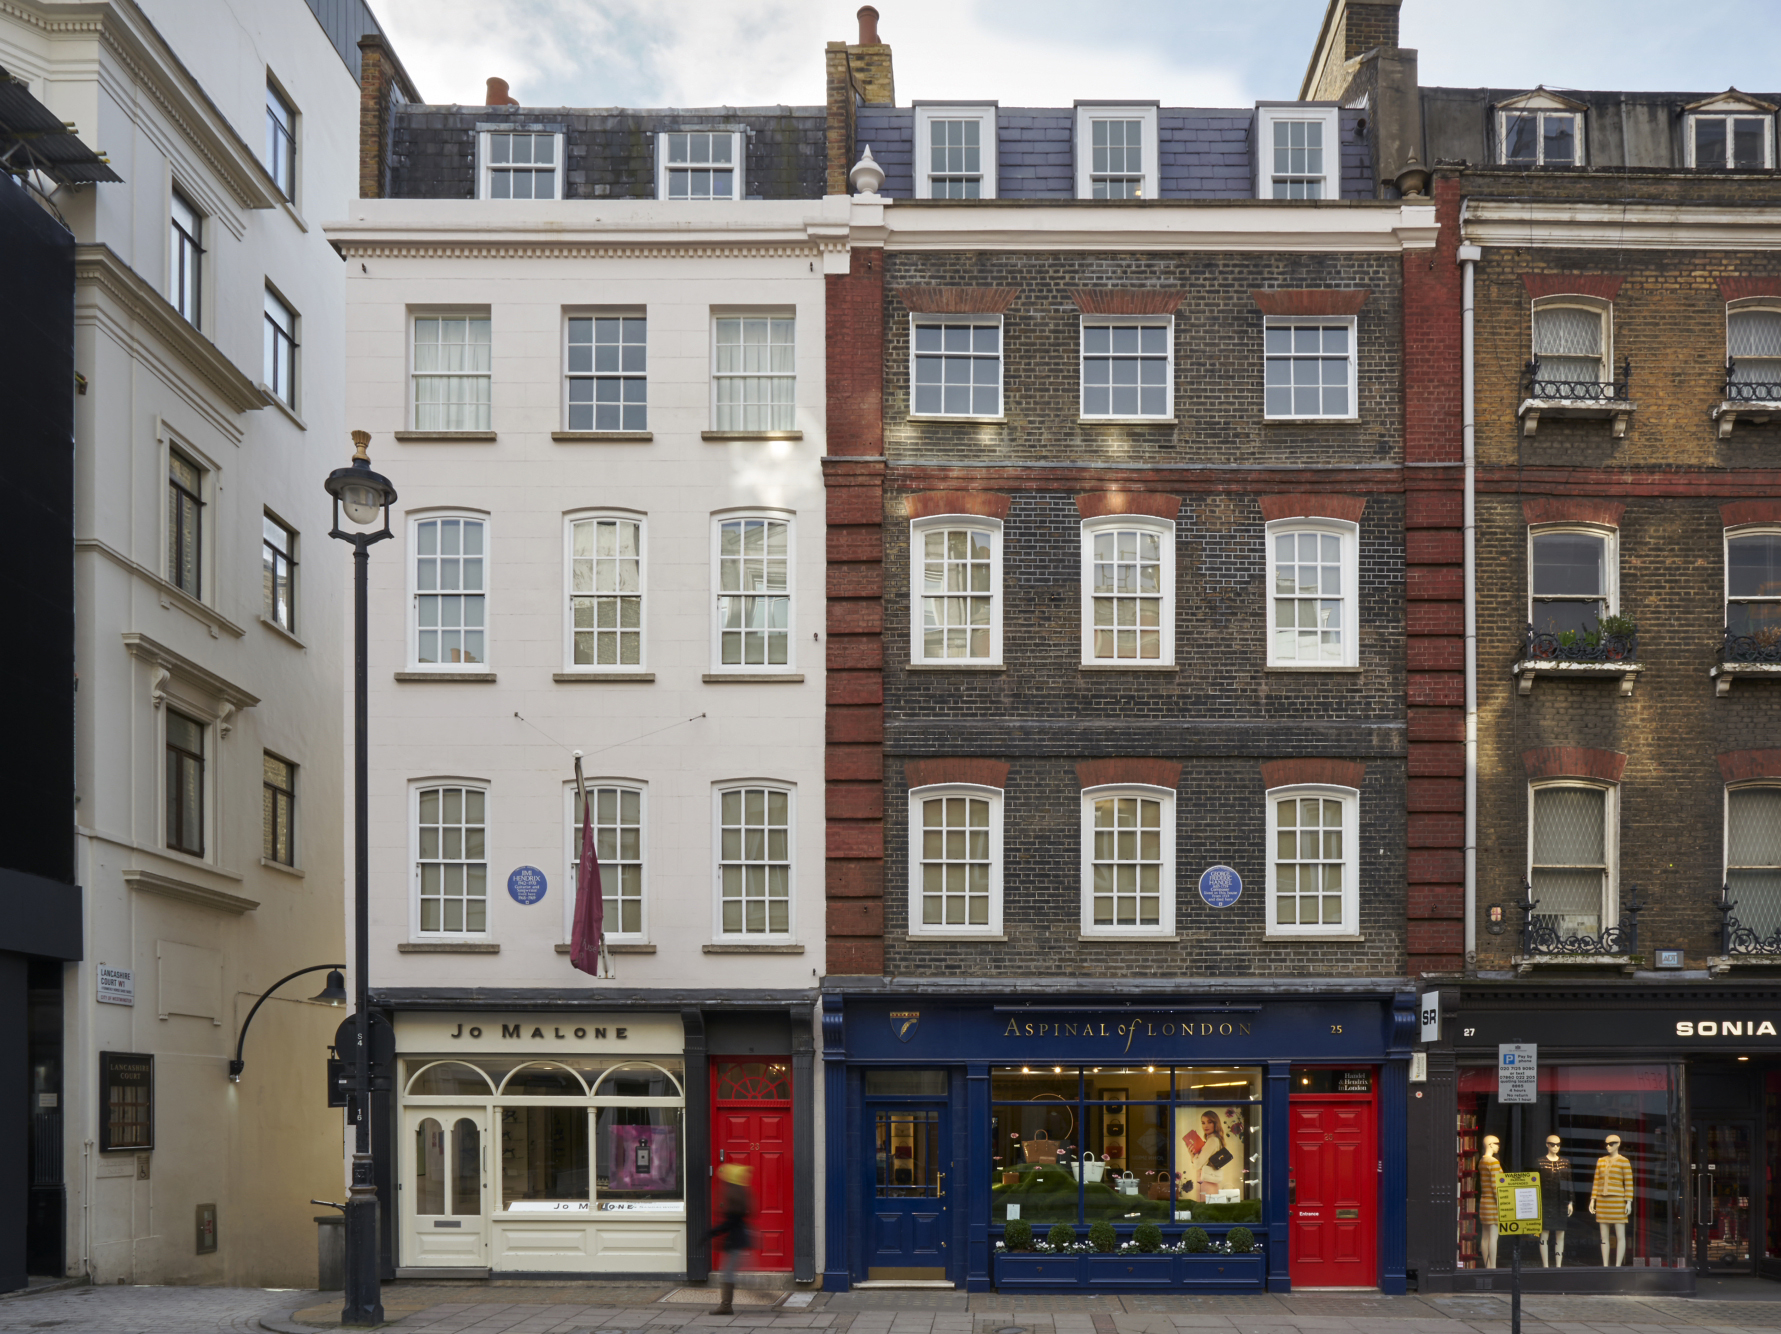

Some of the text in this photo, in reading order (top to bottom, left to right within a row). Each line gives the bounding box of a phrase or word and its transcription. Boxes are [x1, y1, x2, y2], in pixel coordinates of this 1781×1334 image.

[100, 969, 131, 981] LANCASHIRE
[100, 977, 126, 988] COURT W1
[1422, 1009, 1437, 1025] SR
[1330, 1025, 1343, 1034] 25
[1463, 1028, 1475, 1037] 27
[1676, 1021, 1777, 1036] SONIA
[1004, 1017, 1251, 1055] ASPINAL of LONDON
[110, 1063, 149, 1072] LANCASHIRE
[120, 1072, 141, 1080] COURT
[749, 1142, 760, 1151] 23
[1499, 1222, 1519, 1233] NO
